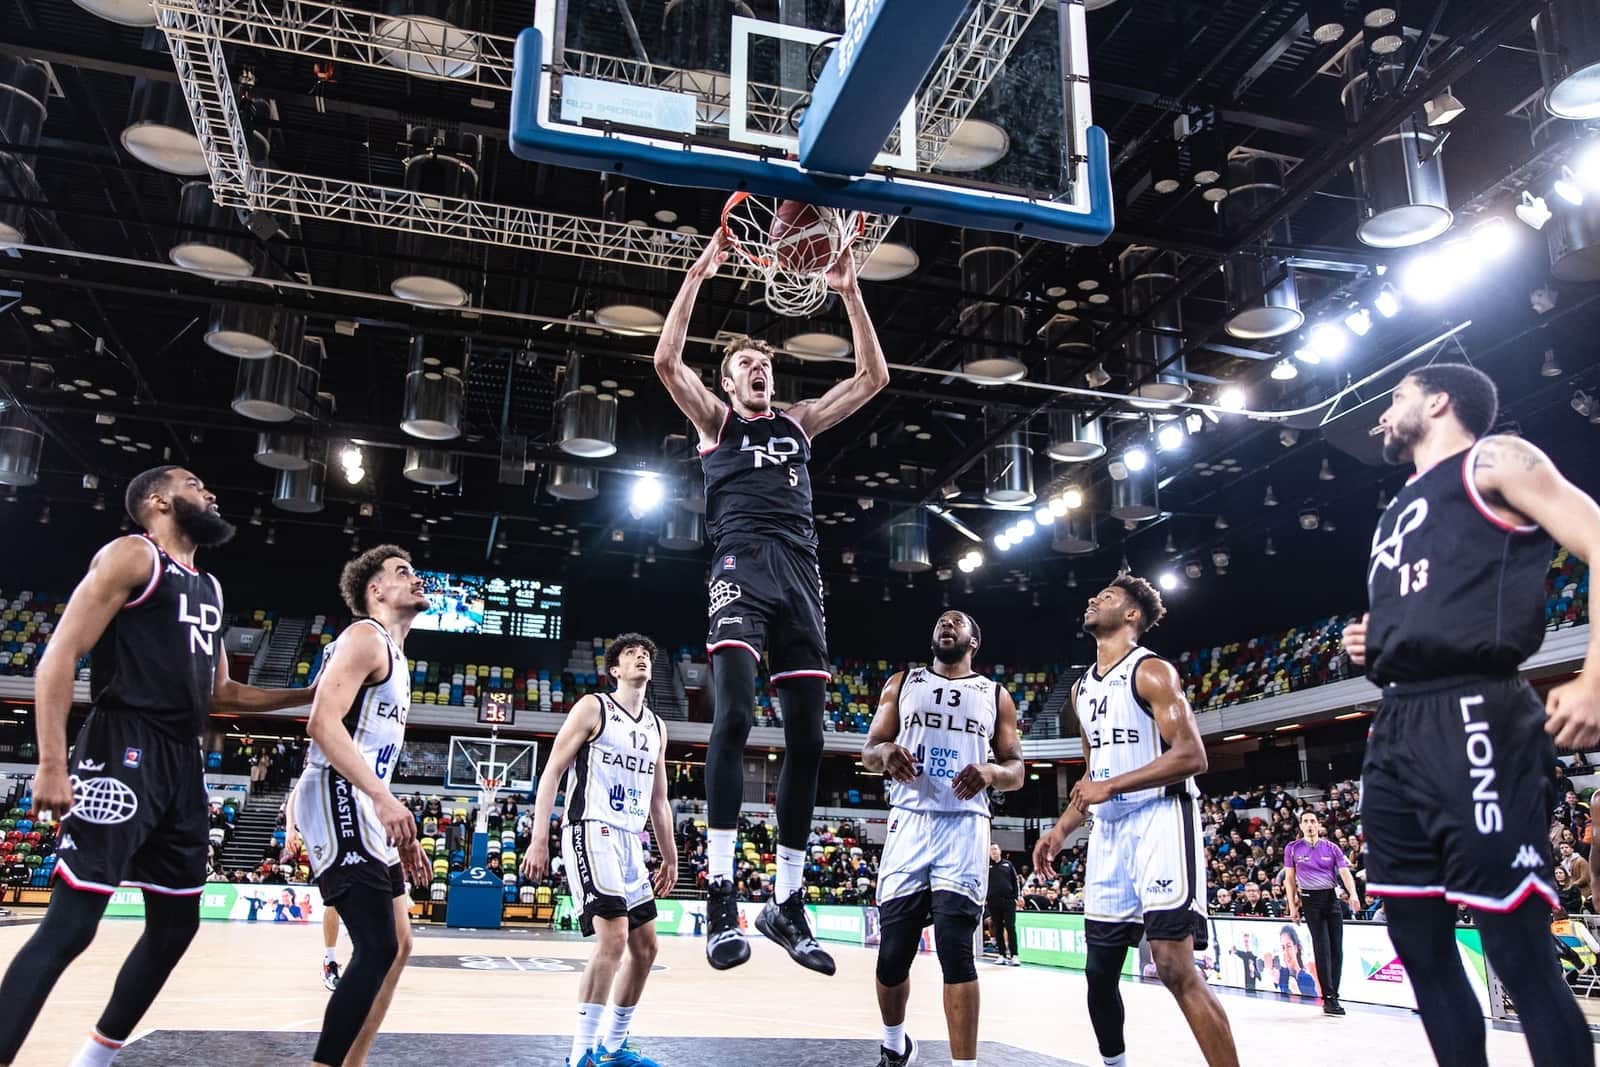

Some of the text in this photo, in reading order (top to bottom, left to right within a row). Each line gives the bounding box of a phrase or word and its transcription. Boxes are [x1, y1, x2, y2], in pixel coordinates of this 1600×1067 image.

[788, 467, 799, 487] 5
[1398, 558, 1430, 597] 13
[932, 687, 962, 708] 13
[1089, 695, 1108, 722] 24
[629, 730, 649, 752] 12
[930, 747, 959, 760] GIVE
[930, 757, 947, 768] TO
[1459, 694, 1504, 835] LIONS
